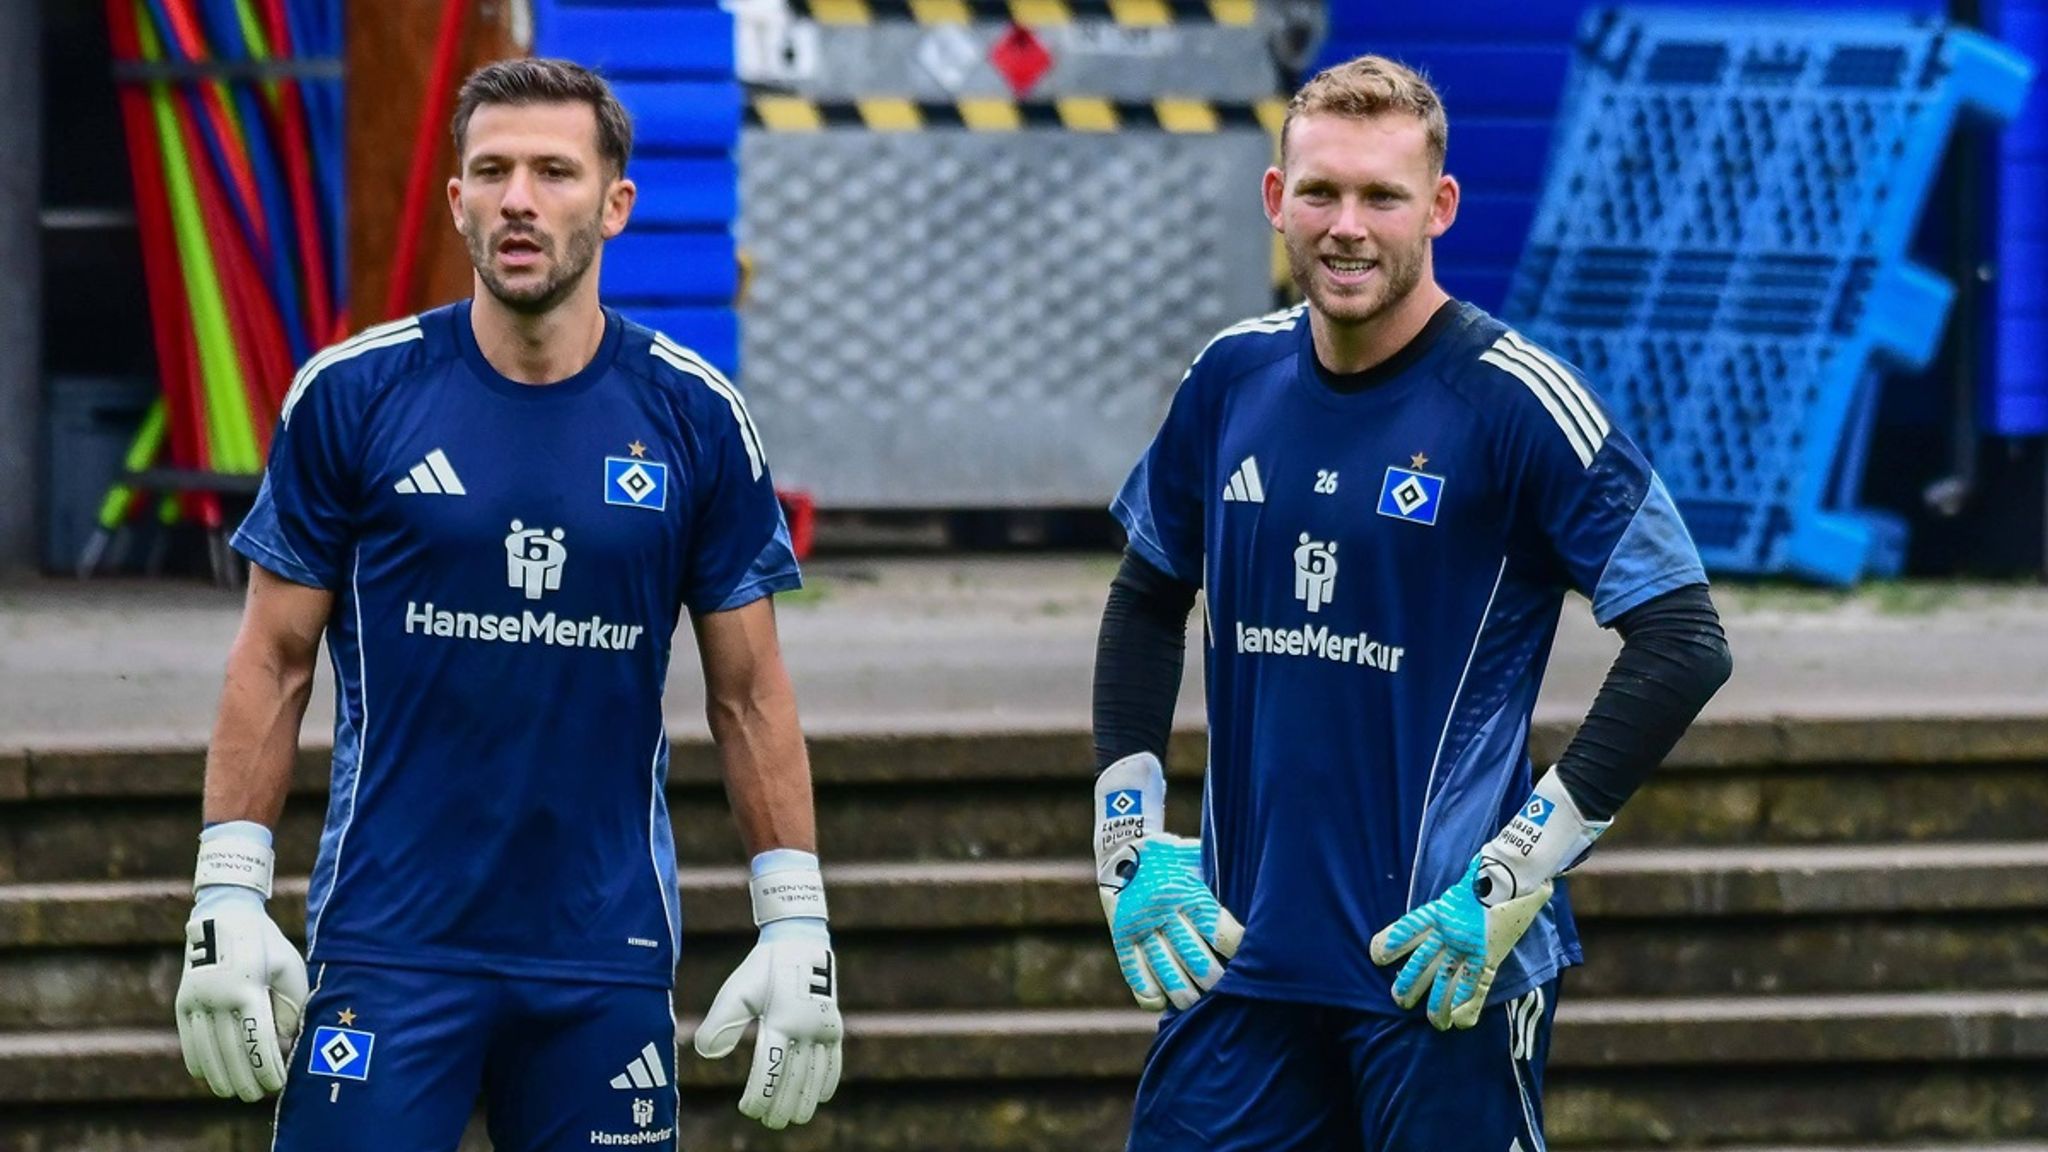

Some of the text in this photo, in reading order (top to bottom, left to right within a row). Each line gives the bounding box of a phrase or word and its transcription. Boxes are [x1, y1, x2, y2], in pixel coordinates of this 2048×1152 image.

[1313, 469, 1339, 494] 26
[405, 601, 643, 650] HanseMerkur
[1102, 829, 1143, 851] Daniel
[209, 863, 253, 873] DANIEL
[330, 1082, 341, 1103] 1
